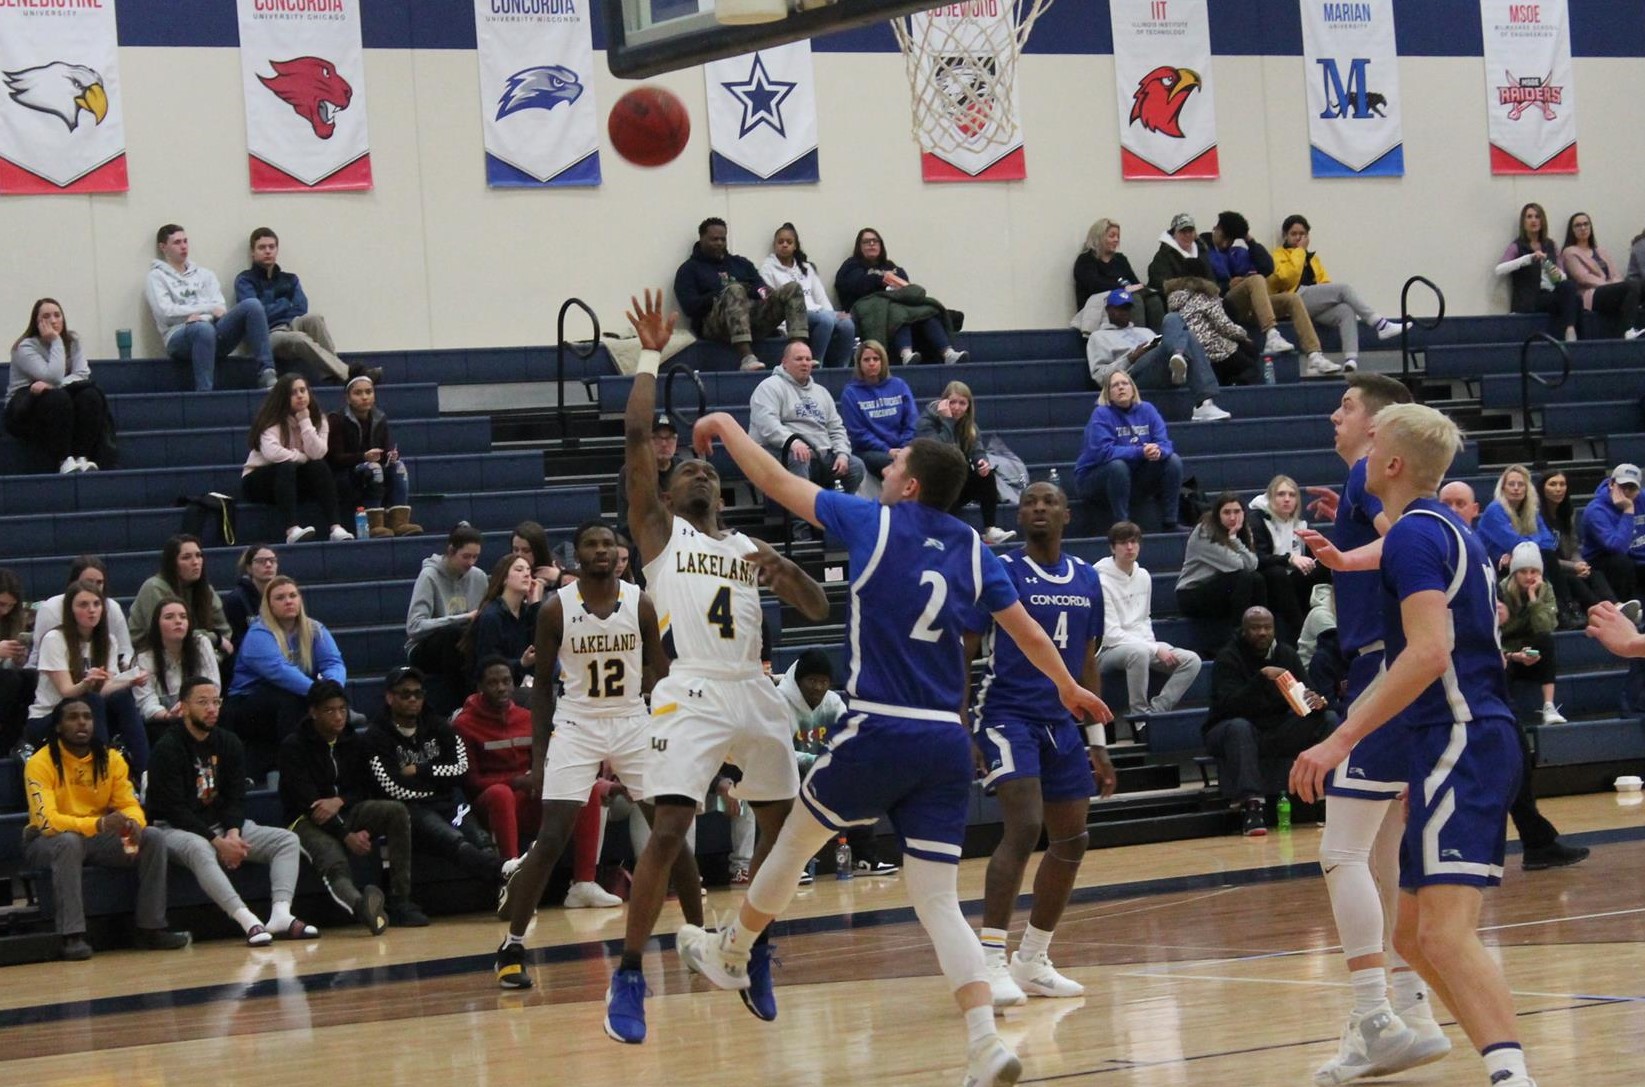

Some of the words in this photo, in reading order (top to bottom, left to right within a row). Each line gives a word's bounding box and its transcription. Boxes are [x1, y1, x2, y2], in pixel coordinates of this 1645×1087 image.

[491, 0, 575, 14] CONCORDIA
[1151, 1, 1167, 20] IIT
[1323, 3, 1371, 22] MARIAN
[1509, 5, 1541, 23] MSOE
[1499, 87, 1562, 104] RAIDERS
[909, 570, 948, 643] 2
[1030, 594, 1092, 608] CONCORDIA
[707, 585, 736, 640] 4
[1053, 611, 1069, 649] 4
[571, 633, 637, 654] LAKELAND
[587, 658, 625, 698] 12
[651, 736, 669, 752] LU
